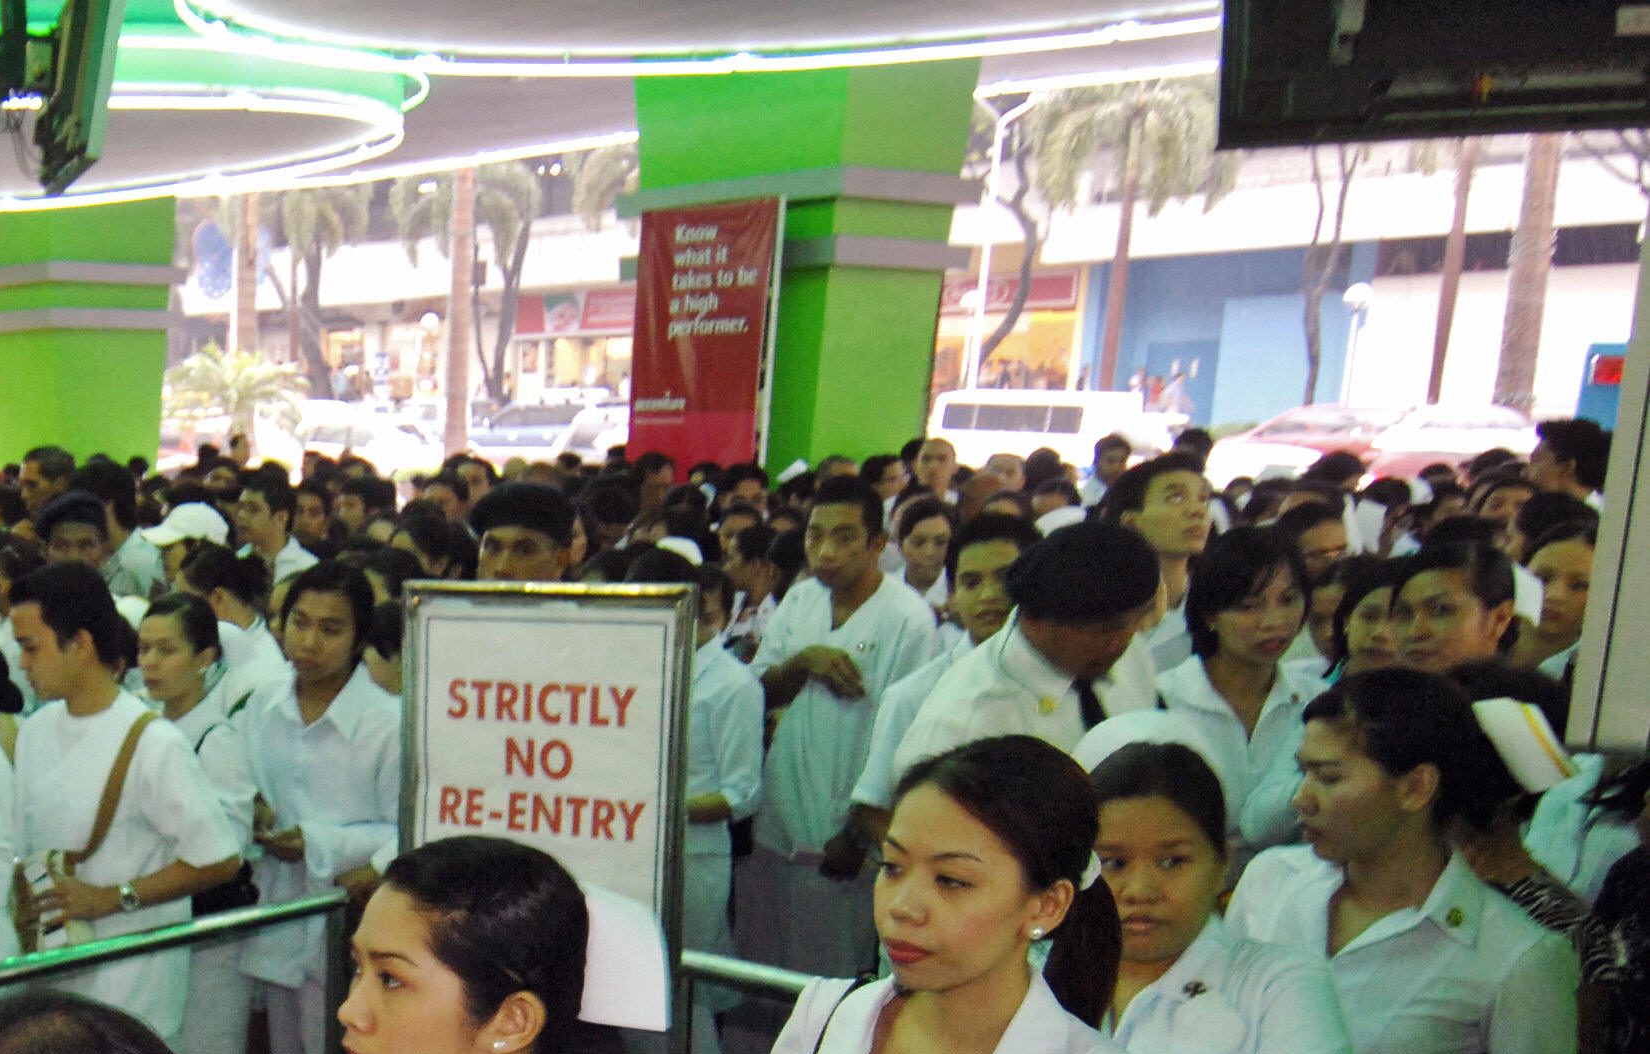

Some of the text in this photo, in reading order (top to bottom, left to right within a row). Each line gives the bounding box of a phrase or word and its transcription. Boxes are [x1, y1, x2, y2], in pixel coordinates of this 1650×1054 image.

[675, 224, 718, 244] Know
[674, 244, 728, 268] what it
[672, 265, 758, 291] takes to be
[669, 291, 719, 321] a high
[668, 315, 748, 341] performer.
[447, 679, 637, 728] STRICTLY
[505, 737, 574, 780] NO
[438, 786, 646, 842] RE-ENTRY
